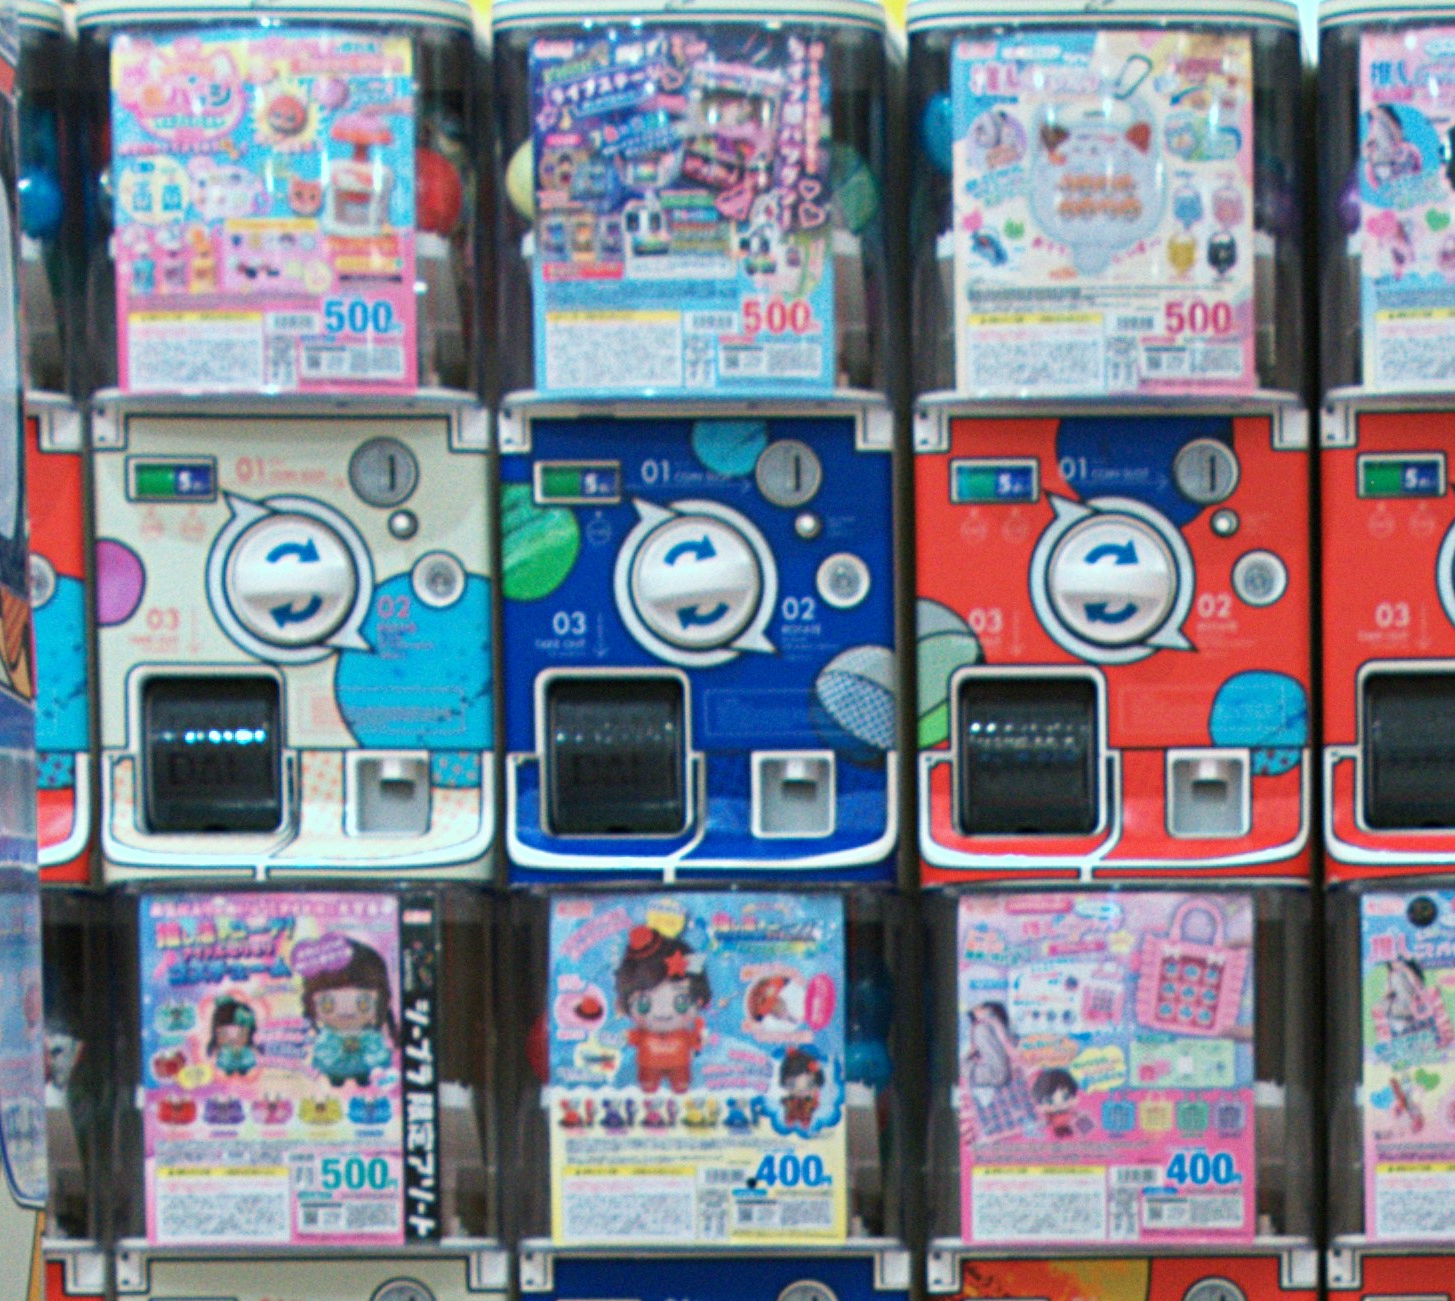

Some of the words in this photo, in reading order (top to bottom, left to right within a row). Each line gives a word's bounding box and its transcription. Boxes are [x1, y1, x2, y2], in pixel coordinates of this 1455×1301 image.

[641, 460, 669, 484] 01
[1060, 458, 1089, 482] 01
[782, 597, 815, 620] 02
[1198, 593, 1231, 618] 02
[1375, 603, 1409, 627] 03
[553, 611, 586, 635] 03
[970, 609, 1002, 633] 03
